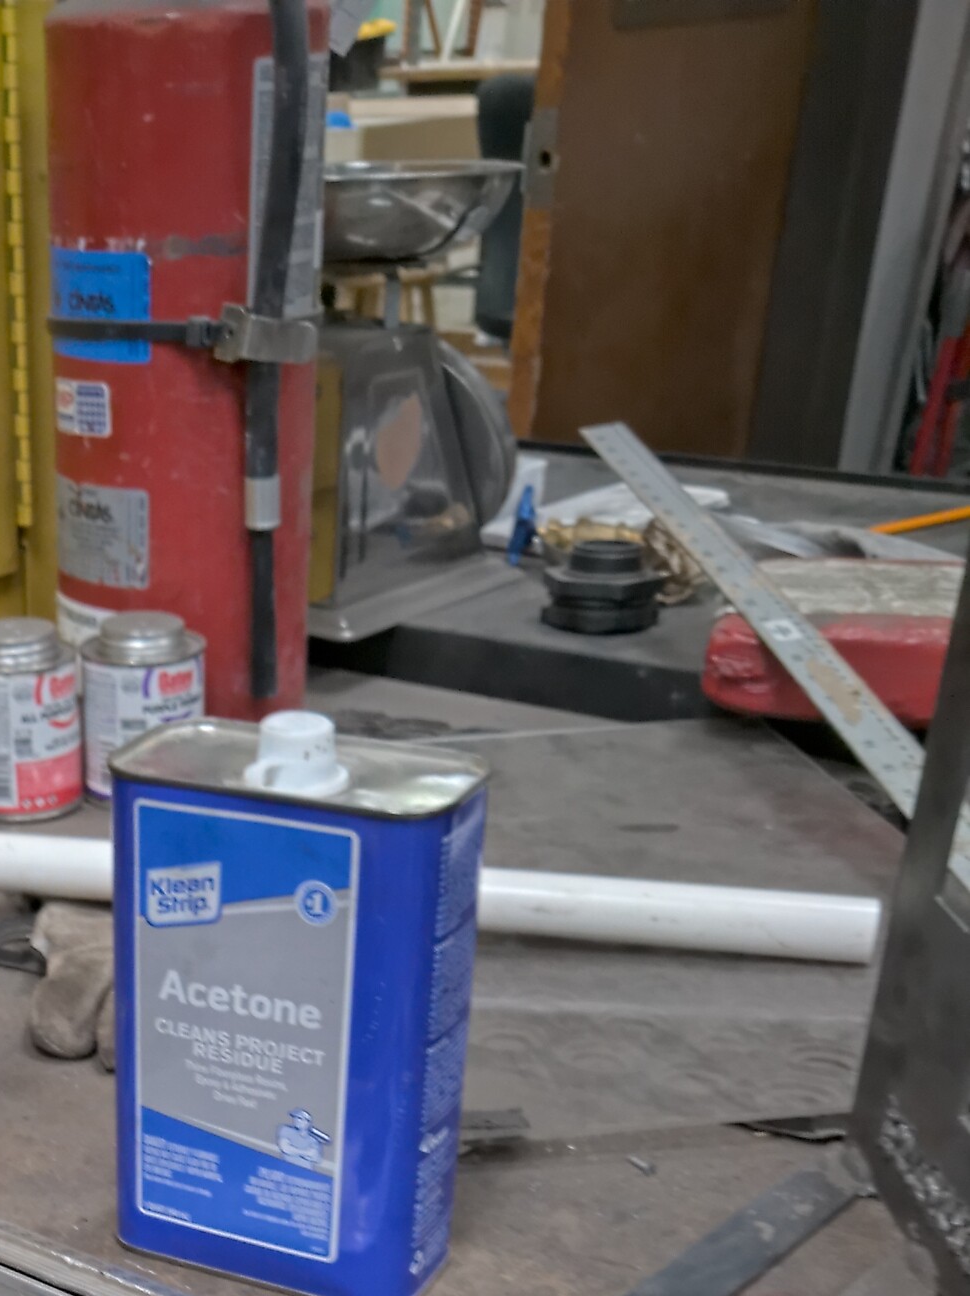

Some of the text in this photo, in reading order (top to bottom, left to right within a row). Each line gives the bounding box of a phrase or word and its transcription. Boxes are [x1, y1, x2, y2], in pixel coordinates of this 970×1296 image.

[150, 876, 215, 897] Klean
[158, 968, 323, 1030] Acetone
[154, 1016, 326, 1067] CLEANS PROJECT
[192, 1040, 284, 1076] RESIDUE
